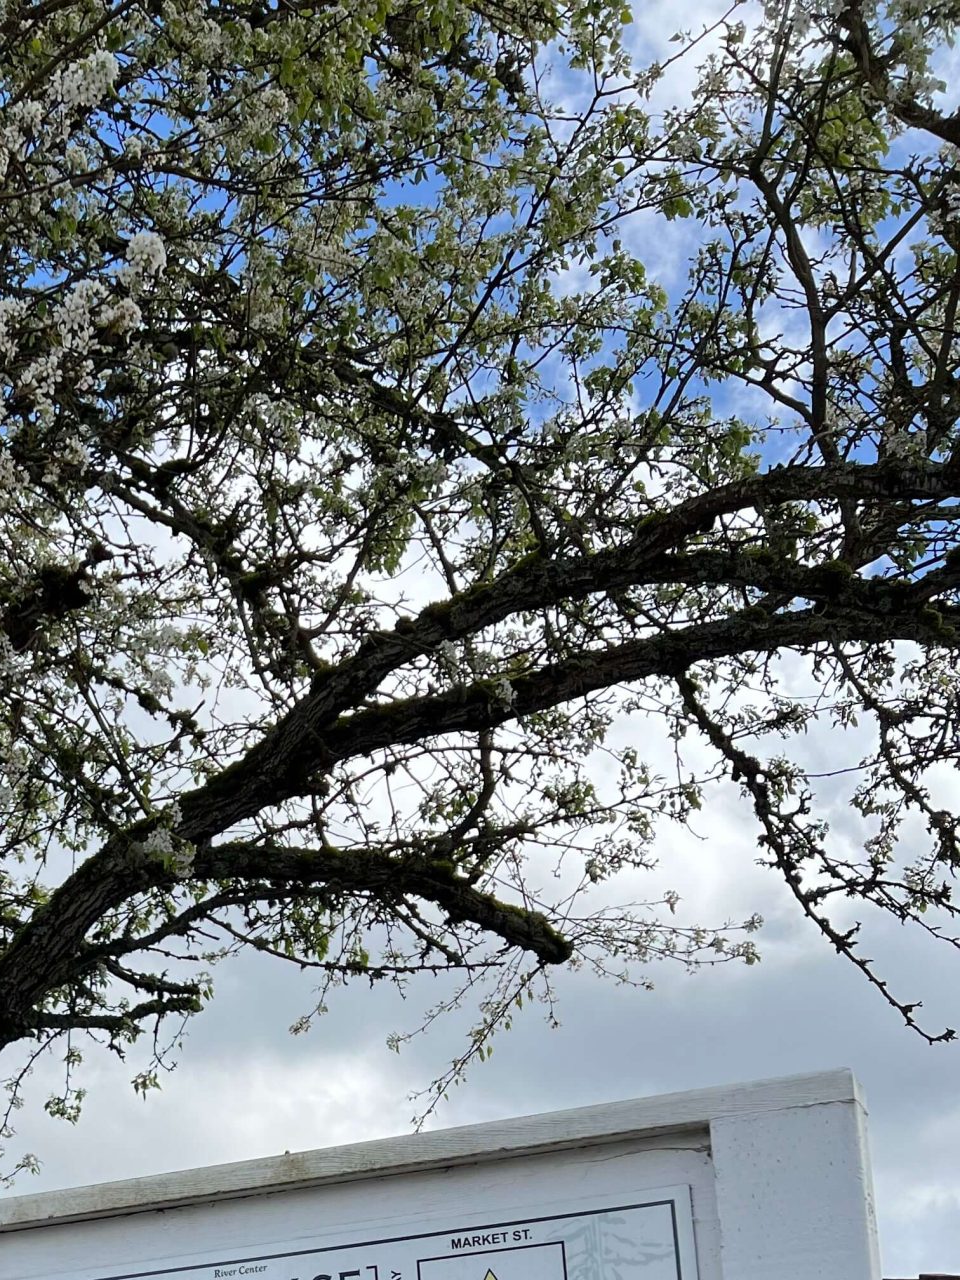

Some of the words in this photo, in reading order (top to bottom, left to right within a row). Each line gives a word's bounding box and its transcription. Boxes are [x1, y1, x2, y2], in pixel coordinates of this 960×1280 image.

[451, 1232, 509, 1250] MARKET
[513, 1229, 533, 1243] ST.
[214, 1269, 237, 1278] River
[239, 1265, 267, 1275] Center
